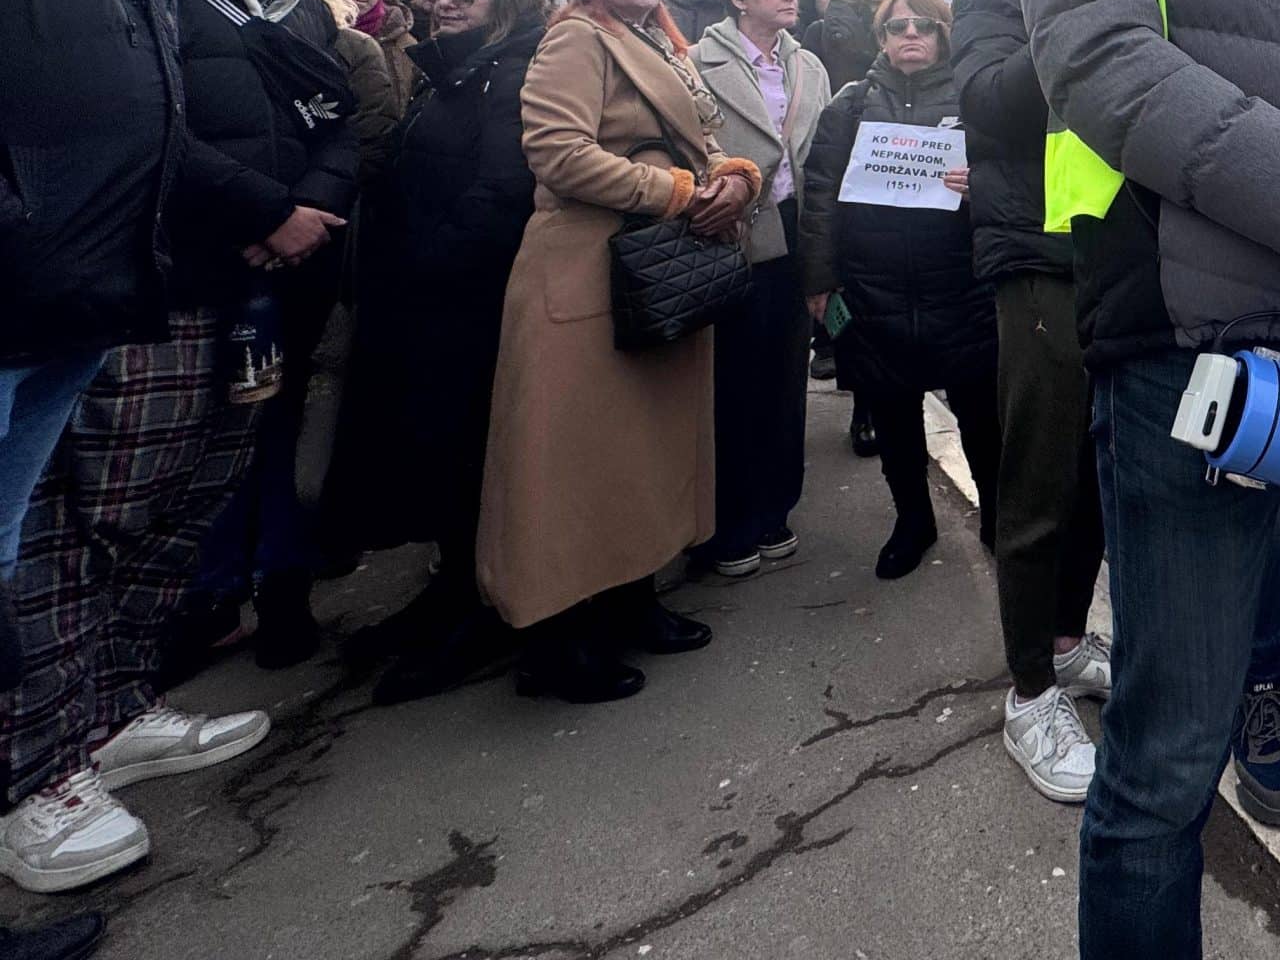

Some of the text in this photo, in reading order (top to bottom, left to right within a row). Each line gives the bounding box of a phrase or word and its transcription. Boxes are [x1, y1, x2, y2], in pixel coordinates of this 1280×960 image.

[294, 99, 316, 129] adidas
[872, 135, 889, 144] KO
[922, 140, 952, 151] PRED
[871, 149, 946, 167] NEPRAVDOM,
[865, 163, 928, 178] PODRŽAVA
[886, 180, 922, 193] (15+1)
